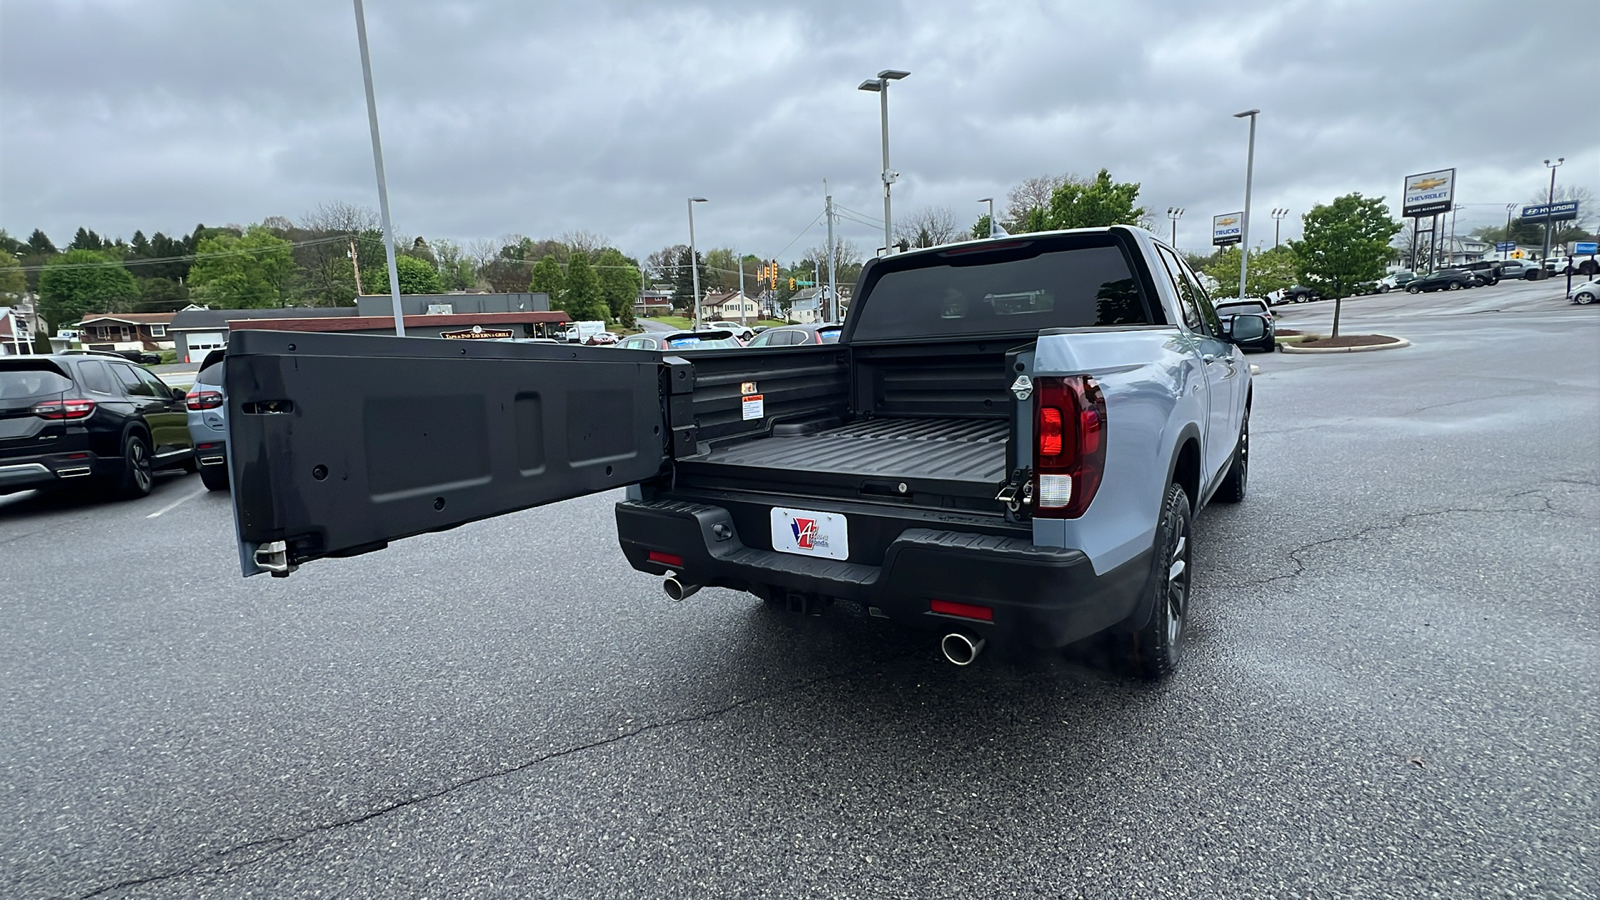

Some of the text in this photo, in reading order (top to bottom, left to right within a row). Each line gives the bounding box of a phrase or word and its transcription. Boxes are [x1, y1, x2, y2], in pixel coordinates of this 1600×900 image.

[1407, 191, 1448, 203] CHEVROLET
[1540, 203, 1575, 213] HYUNDAI
[1215, 227, 1240, 236] TRUCKS
